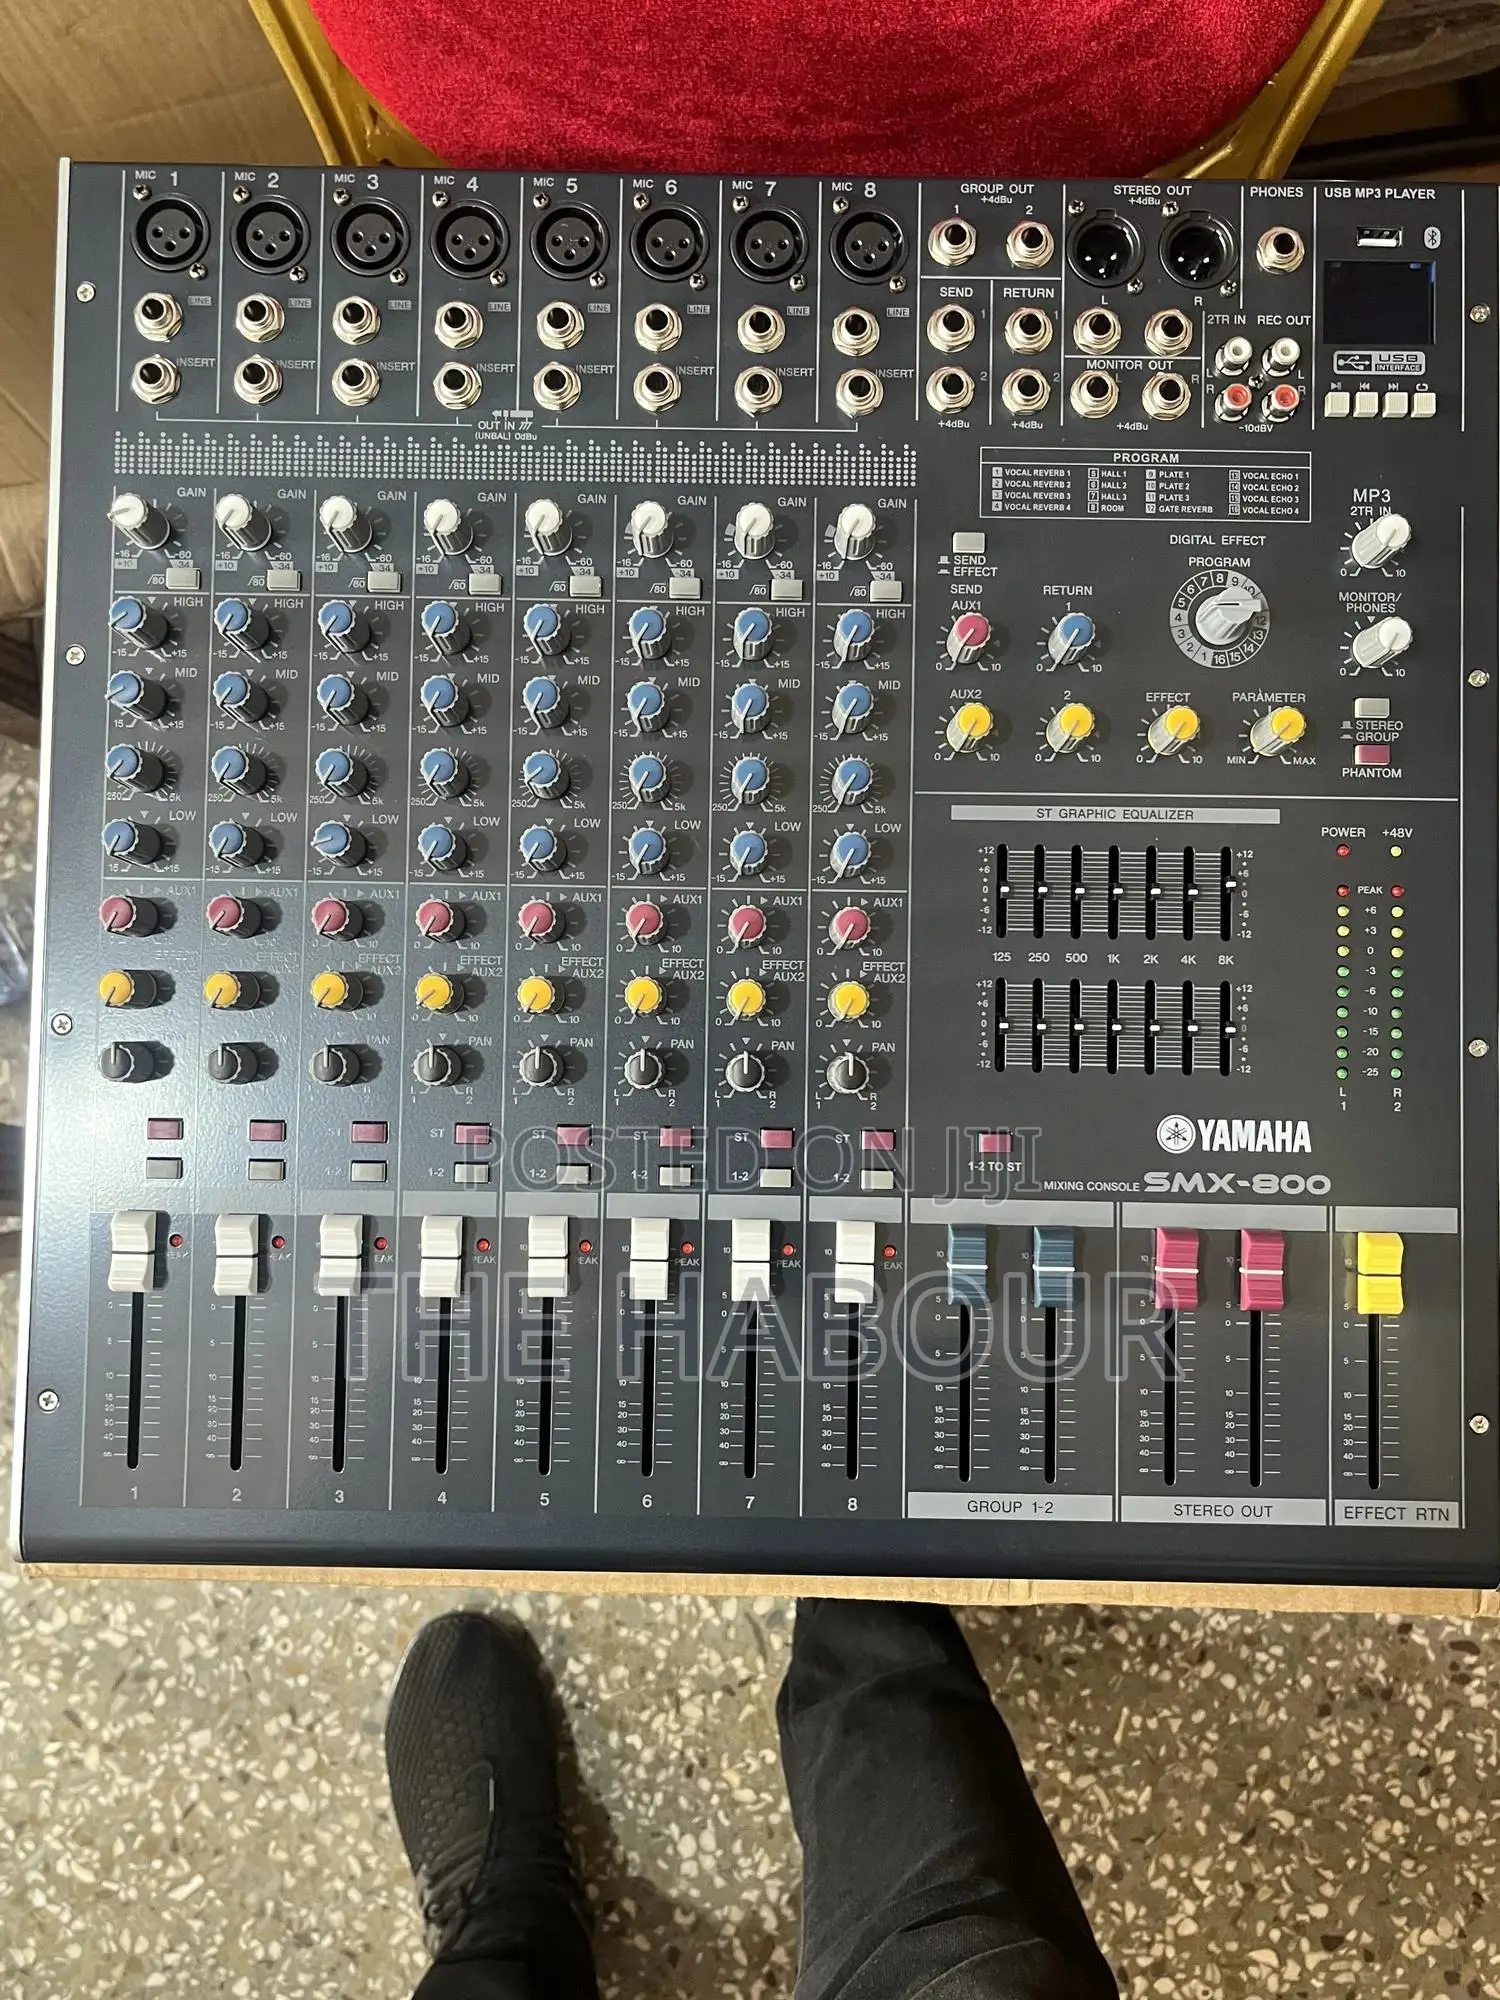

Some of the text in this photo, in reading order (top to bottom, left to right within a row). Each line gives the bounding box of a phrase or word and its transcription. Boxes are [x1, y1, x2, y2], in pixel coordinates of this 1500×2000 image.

[135, 170, 179, 186] MIC 1
[235, 172, 279, 188] MIC 2
[335, 174, 378, 189] MIC 3
[434, 176, 478, 191] MIC 4
[534, 178, 577, 193] MIC 5
[633, 179, 677, 195] MIC 6
[732, 181, 776, 196] MIC 7
[961, 184, 1034, 193] GROUP OUT
[832, 182, 876, 197] MIC 8
[1114, 185, 1192, 196] STEREO OUT
[1250, 187, 1303, 197] PHONES
[1325, 188, 1435, 199] USB MP3 PLAYER
[981, 196, 1012, 204] +4dBu
[1129, 197, 1160, 205] +4dBu
[954, 205, 958, 214] 1
[1026, 205, 1033, 215] 2
[940, 287, 973, 297] SEND
[1004, 288, 1054, 298] RETURN
[1208, 315, 1246, 324] 2TR IN
[1258, 315, 1311, 325] REC OUT
[1379, 354, 1418, 362] USB
[576, 365, 615, 374] INSERT
[1087, 360, 1173, 370] MONITOR OUT
[775, 368, 814, 377] INSERT
[478, 421, 515, 430] OUT IN
[938, 420, 969, 428] +4dBu
[1012, 421, 1043, 429] +4dBu
[1117, 422, 1148, 430] +4dBu
[1239, 424, 1273, 432] -10dBV
[475, 432, 511, 440] (UNBAL)
[1113, 453, 1179, 464] PROGRAM
[1033, 469, 1066, 477] REVERB
[1242, 472, 1270, 480] VOCAL
[1271, 472, 1293, 480] ECHO
[177, 487, 206, 497] GAIN
[1353, 489, 1391, 502] MP3
[878, 498, 907, 509] GAIN
[1159, 505, 1179, 513] GATE
[1242, 506, 1269, 514] VOCAL
[1351, 506, 1391, 516] 2TR IN
[1170, 535, 1266, 545] DIGITAL EFFECT
[954, 555, 986, 565] SEND
[1189, 557, 1250, 567] PROGRAM
[954, 567, 998, 576] EFFECT
[950, 584, 982, 594] SEND
[1043, 586, 1092, 595] RETURN
[174, 597, 203, 607] HIGH
[1339, 592, 1401, 603] MONITOR/
[476, 602, 505, 613] HIGH
[952, 601, 981, 610] AUX1
[1347, 603, 1396, 613] PHONES
[876, 609, 905, 619] HIGH
[175, 668, 197, 678] MID
[477, 673, 499, 683] MID
[878, 680, 901, 690] MID
[950, 689, 981, 699] AUX2
[1146, 693, 1191, 702] EFFECT
[1232, 692, 1306, 703] PARAMETER
[1356, 720, 1403, 731] STEREO
[1356, 732, 1399, 742] GROUP
[1227, 756, 1246, 764] MIN
[1293, 757, 1316, 765] MAX
[1343, 768, 1401, 778] PHANTOM
[169, 811, 196, 821] LOW
[1036, 808, 1194, 820] ST GRAPHIC EQUALIZER
[473, 817, 500, 826] LOW
[875, 823, 901, 833] LOW
[1322, 827, 1365, 837] POWER
[1382, 828, 1412, 838] +48V
[1358, 886, 1382, 894] PEAK
[471, 891, 501, 901] AUX1
[873, 897, 902, 907] AUX1
[460, 955, 503, 966] EFFECT
[993, 952, 1011, 962] 125
[1028, 953, 1049, 962] 250
[1065, 953, 1088, 963] 500
[1107, 954, 1120, 963] 1K
[1144, 954, 1158, 964] 2K
[1181, 955, 1196, 964] 4K
[1218, 955, 1234, 965] 8K
[472, 967, 503, 977] AUX2
[862, 962, 905, 972] EFFECT
[874, 973, 905, 983] AUX2
[469, 1036, 492, 1046] PAN
[872, 1043, 895, 1052] PAN
[1362, 1068, 1378, 1076] -25
[1198, 1119, 1311, 1153] YAMAHA
[968, 1161, 1023, 1172] 1-2 TO ST
[1044, 1181, 1140, 1192] MIXING CONSOLE
[1144, 1172, 1331, 1195] SMX-800
[131, 1486, 138, 1499] 1
[232, 1488, 242, 1501] 2
[335, 1490, 344, 1503] 3
[437, 1491, 447, 1504] 4
[540, 1493, 549, 1506] 5
[642, 1495, 652, 1508] 6
[745, 1496, 755, 1509] 7
[847, 1497, 857, 1511] 8
[968, 1500, 1053, 1513] GROUP 1-2
[1173, 1504, 1272, 1517] STEREO OUT
[1345, 1506, 1449, 1521] EFFECT RTN
